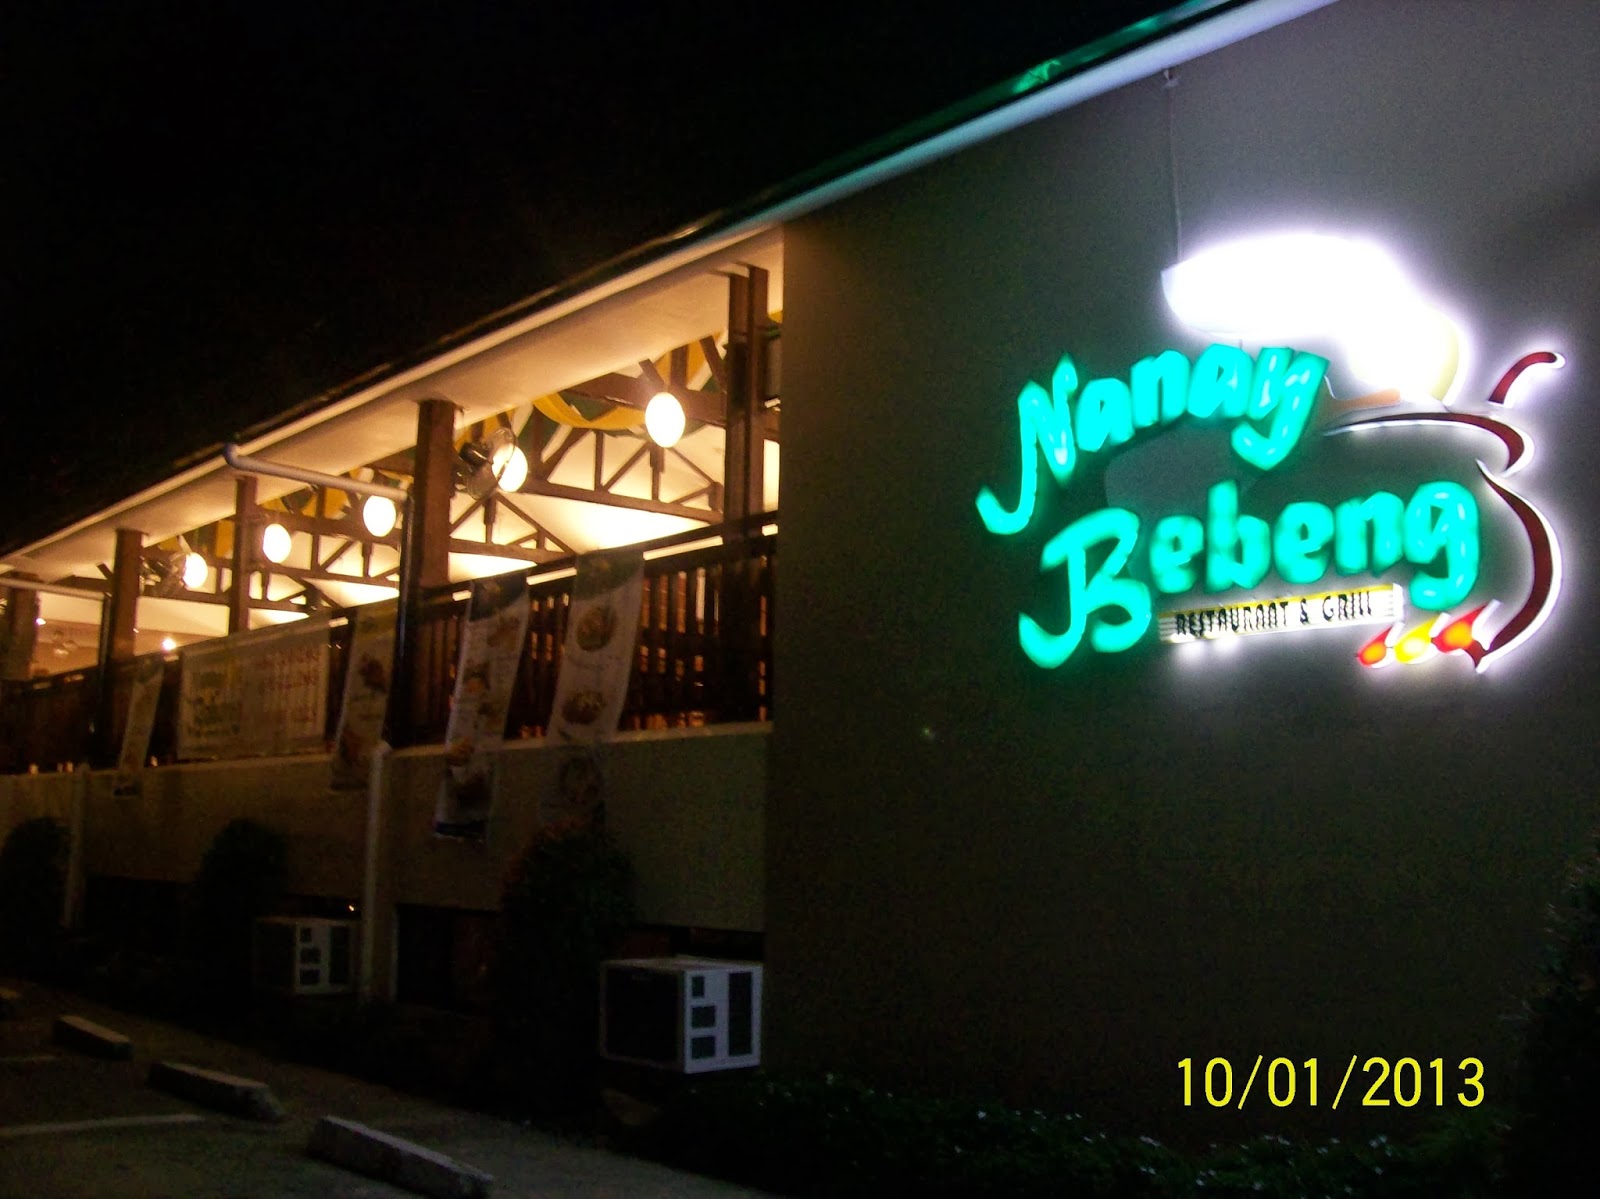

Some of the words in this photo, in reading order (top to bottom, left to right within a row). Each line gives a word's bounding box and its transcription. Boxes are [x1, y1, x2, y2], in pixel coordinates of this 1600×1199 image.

[976, 344, 1329, 534] Nanay
[1018, 480, 1480, 669] Bebeng
[1175, 601, 1289, 637] RESTAURANT
[1322, 590, 1372, 621] GRILL
